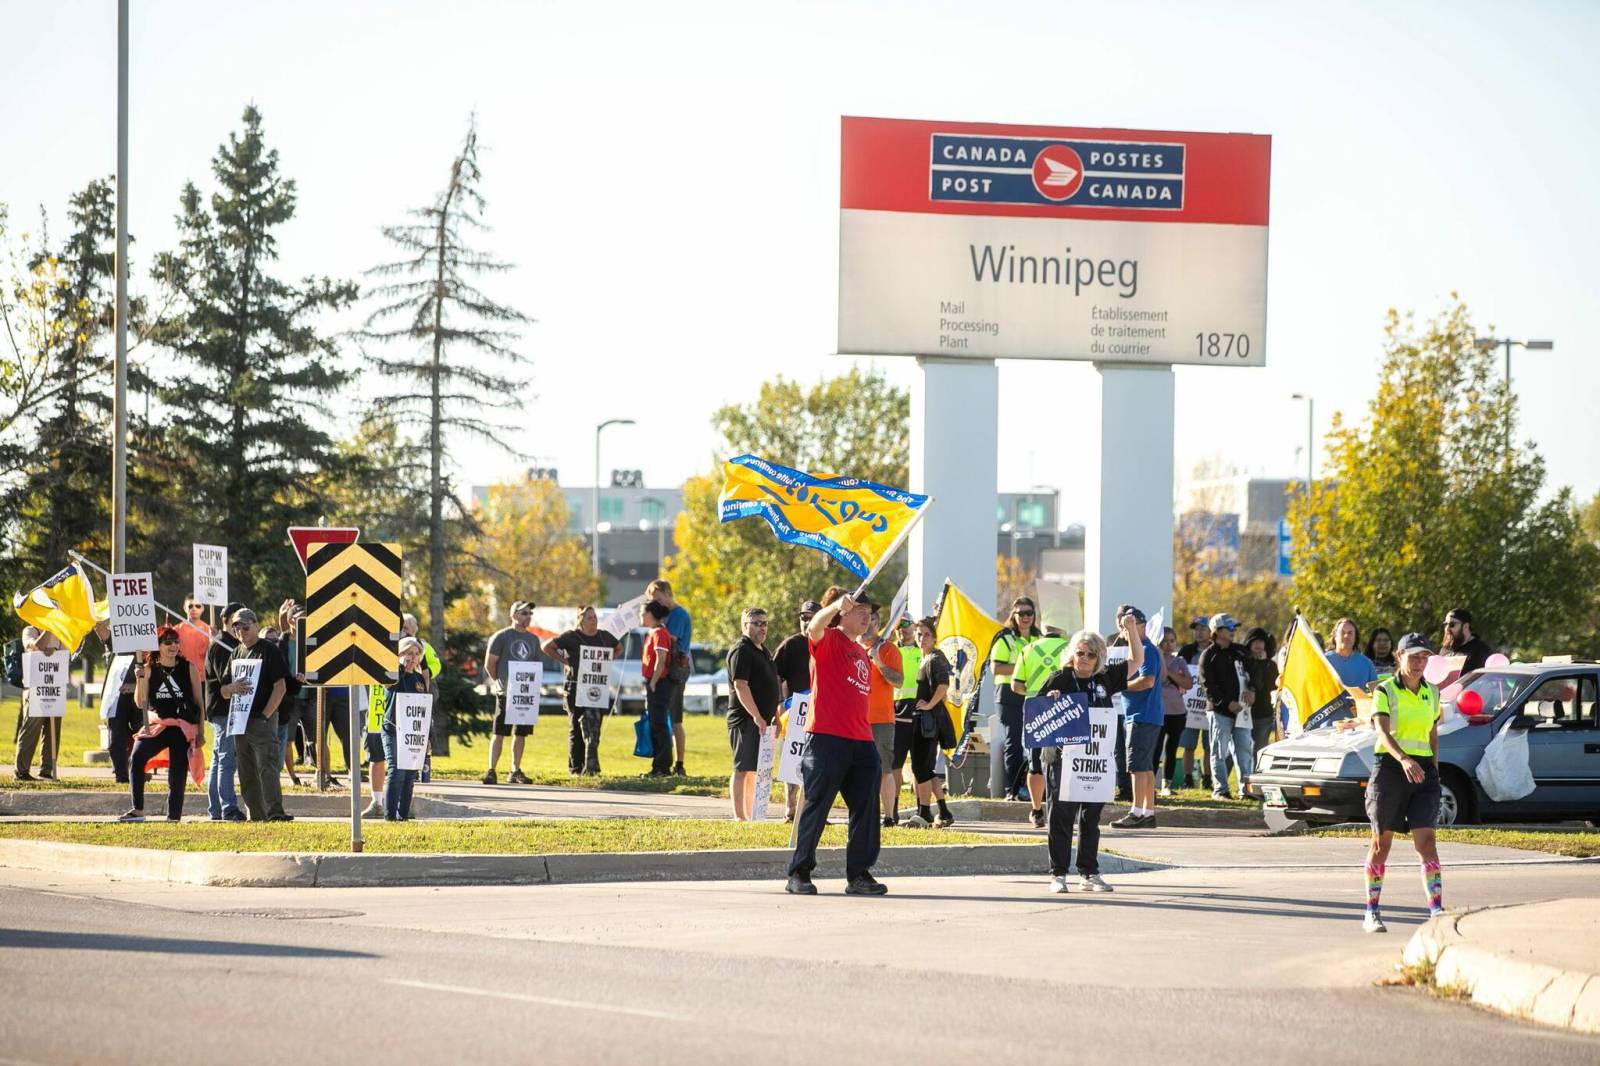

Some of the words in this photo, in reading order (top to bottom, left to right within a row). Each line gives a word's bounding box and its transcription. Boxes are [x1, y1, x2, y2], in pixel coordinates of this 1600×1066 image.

[943, 145, 1027, 163] CANADA
[1090, 151, 1164, 168] POSTES
[941, 177, 993, 194] POST
[1089, 183, 1173, 200] CANADA
[970, 244, 1138, 298] Winnipeg
[940, 300, 965, 315] Mail
[1091, 306, 1168, 322] Établissement
[939, 318, 999, 336] Processing
[1091, 324, 1105, 337] de
[1108, 324, 1166, 339] traitement
[939, 335, 969, 349] Plant
[1091, 340, 1105, 354] du
[1108, 342, 1151, 356] courrier
[1196, 332, 1250, 359] 1870
[198, 549, 223, 560] CUPW
[205, 567, 216, 577] ON
[113, 578, 148, 597] FIRE
[198, 577, 223, 588] STRIKE
[117, 604, 149, 618] DOUG
[113, 623, 157, 638] ETTINGER
[38, 662, 60, 673] CUPW
[234, 664, 255, 678] UPW
[591, 662, 602, 673] ON
[44, 674, 54, 685] ON
[515, 671, 536, 682] CUPW
[582, 673, 608, 686] STRIKE
[36, 686, 61, 697] STRIKE
[520, 683, 530, 694] ON
[512, 695, 535, 706] STRIKE
[406, 705, 427, 718] CUPW
[1025, 694, 1074, 734] Solidarité!
[412, 719, 422, 732] ON
[1033, 703, 1085, 743] Solidarity!
[1090, 723, 1108, 739] PW
[404, 733, 426, 746] STRIKE
[1085, 742, 1099, 756] ON
[1072, 758, 1108, 773] STRIKE
